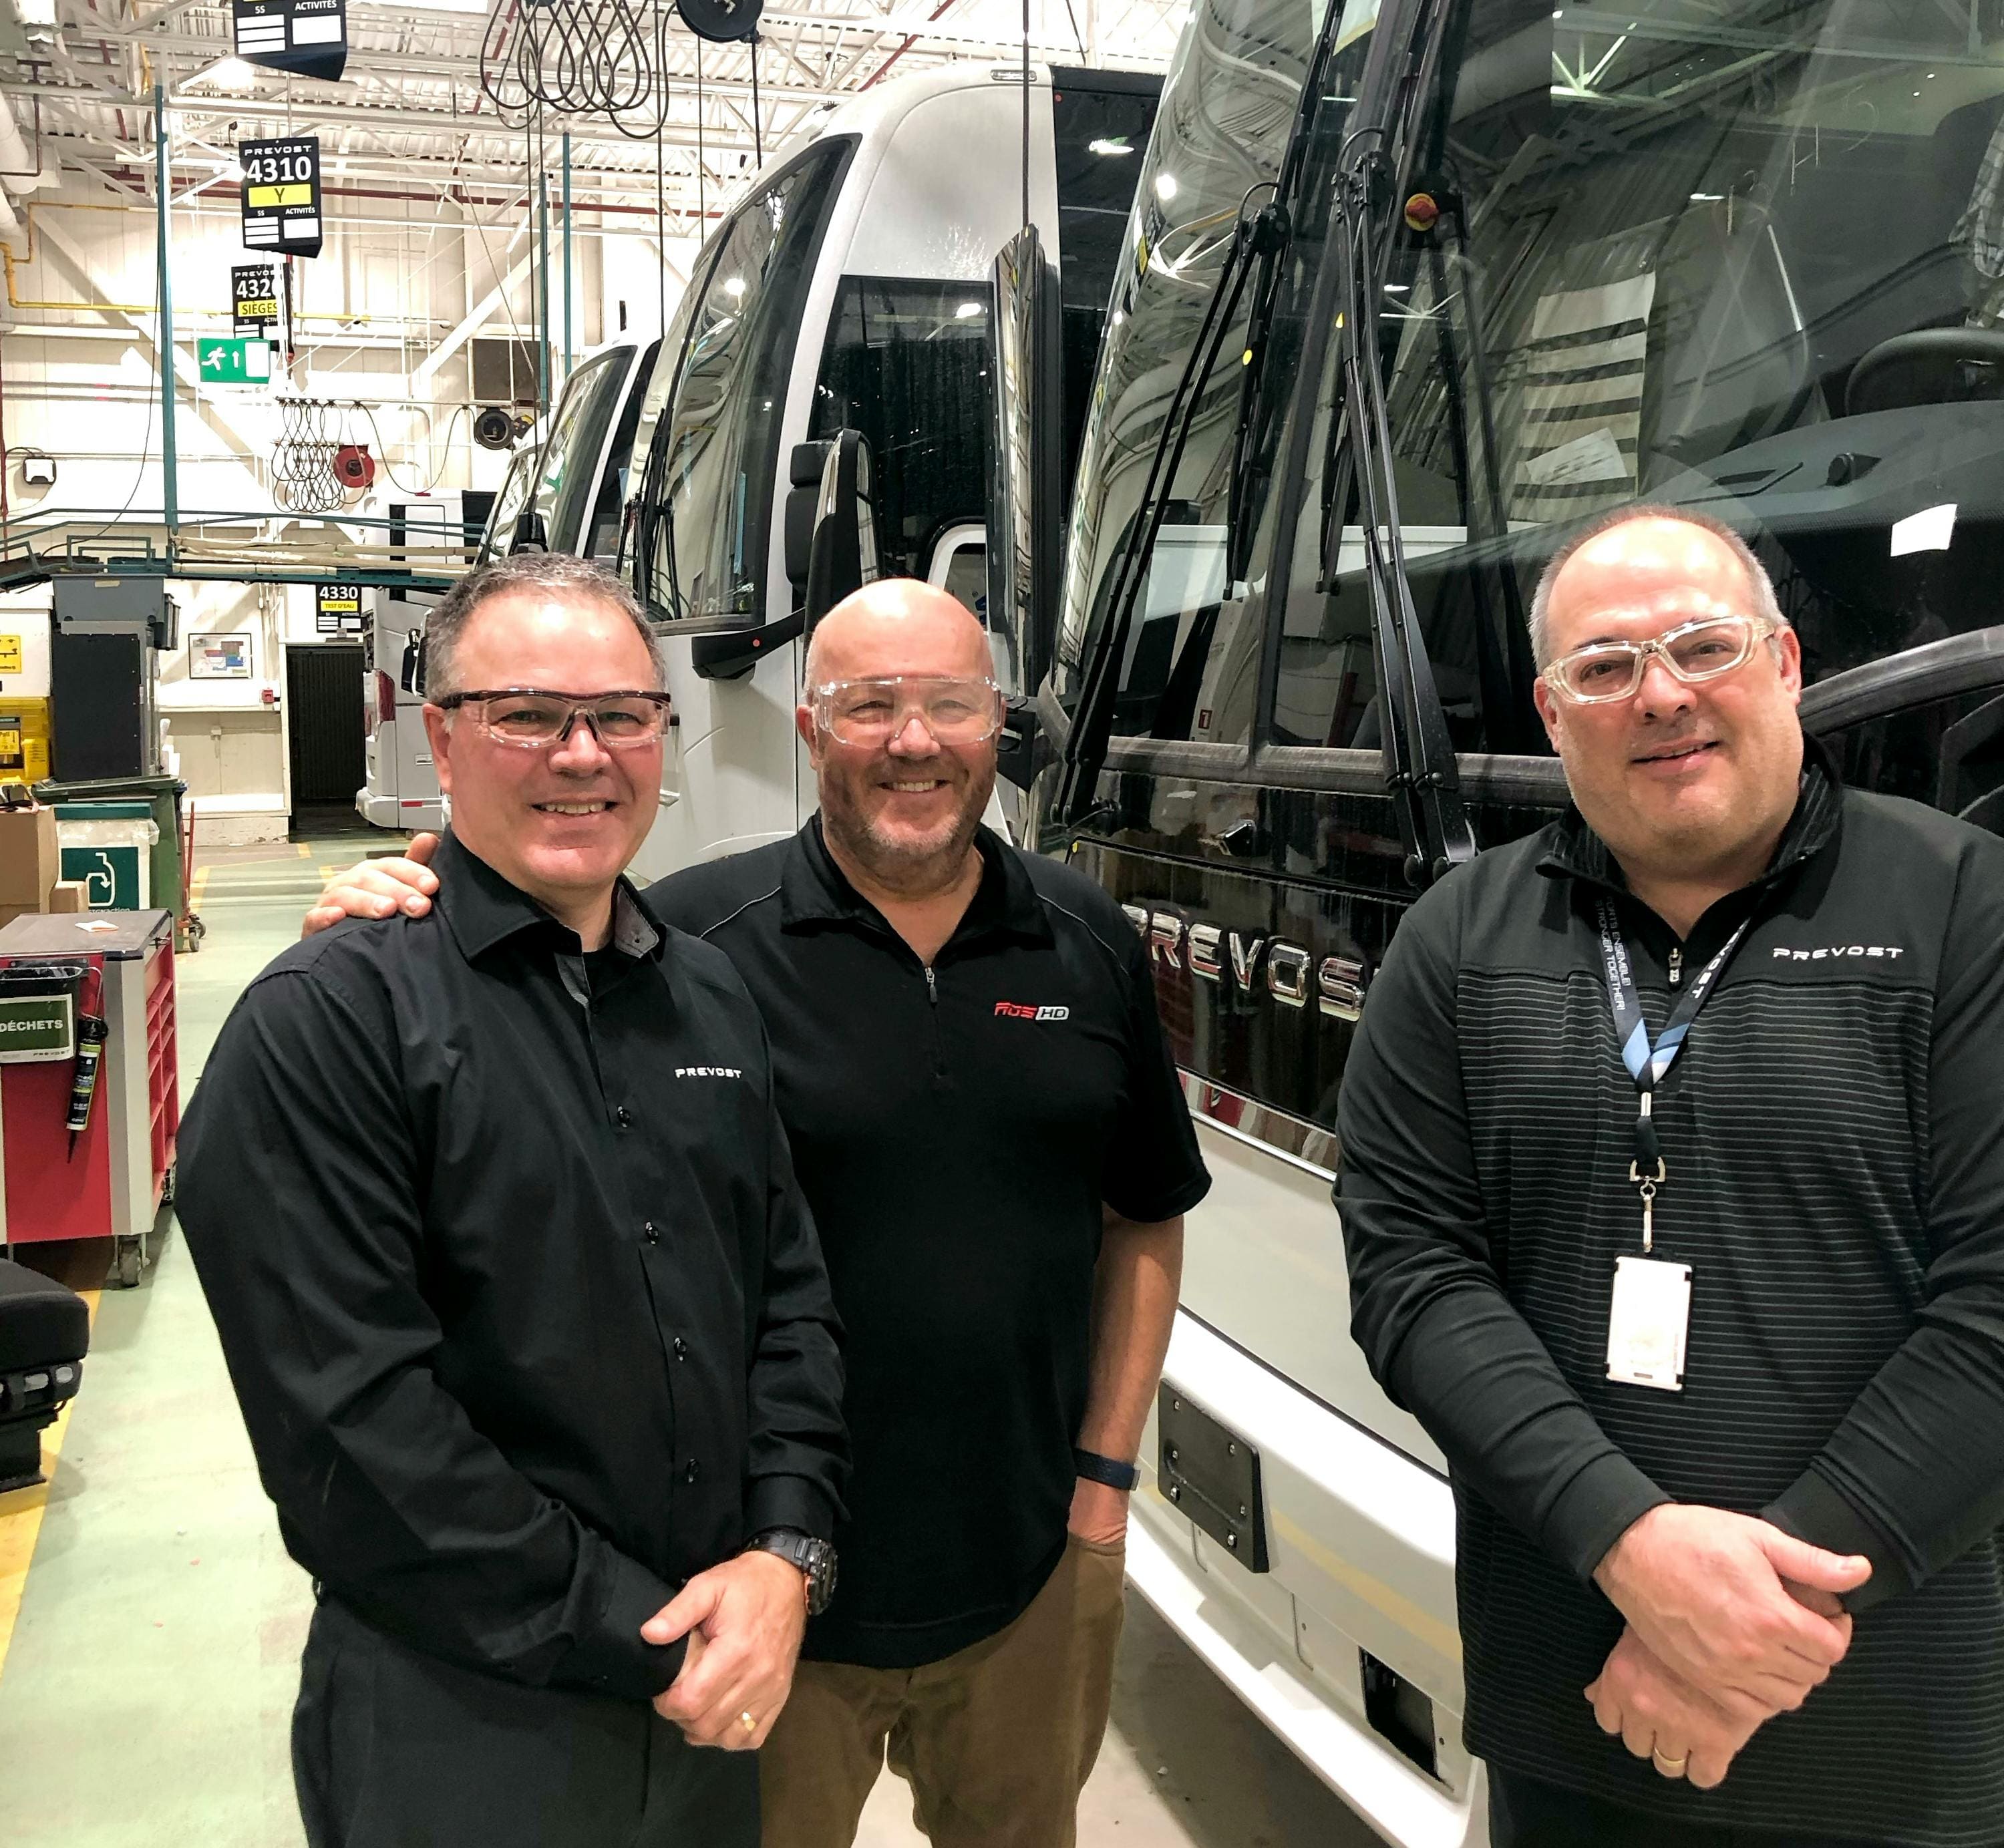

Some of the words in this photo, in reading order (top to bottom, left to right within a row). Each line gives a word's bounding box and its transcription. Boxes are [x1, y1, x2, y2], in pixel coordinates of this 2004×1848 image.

[244, 145, 312, 156] PREVOST
[246, 156, 312, 183] 4310
[274, 187, 285, 204] Y
[285, 206, 315, 215] ACTIVITÉS
[319, 586, 359, 600] 4330
[1772, 946, 1904, 961] PREVOST
[674, 1067, 742, 1079] PREVOST
